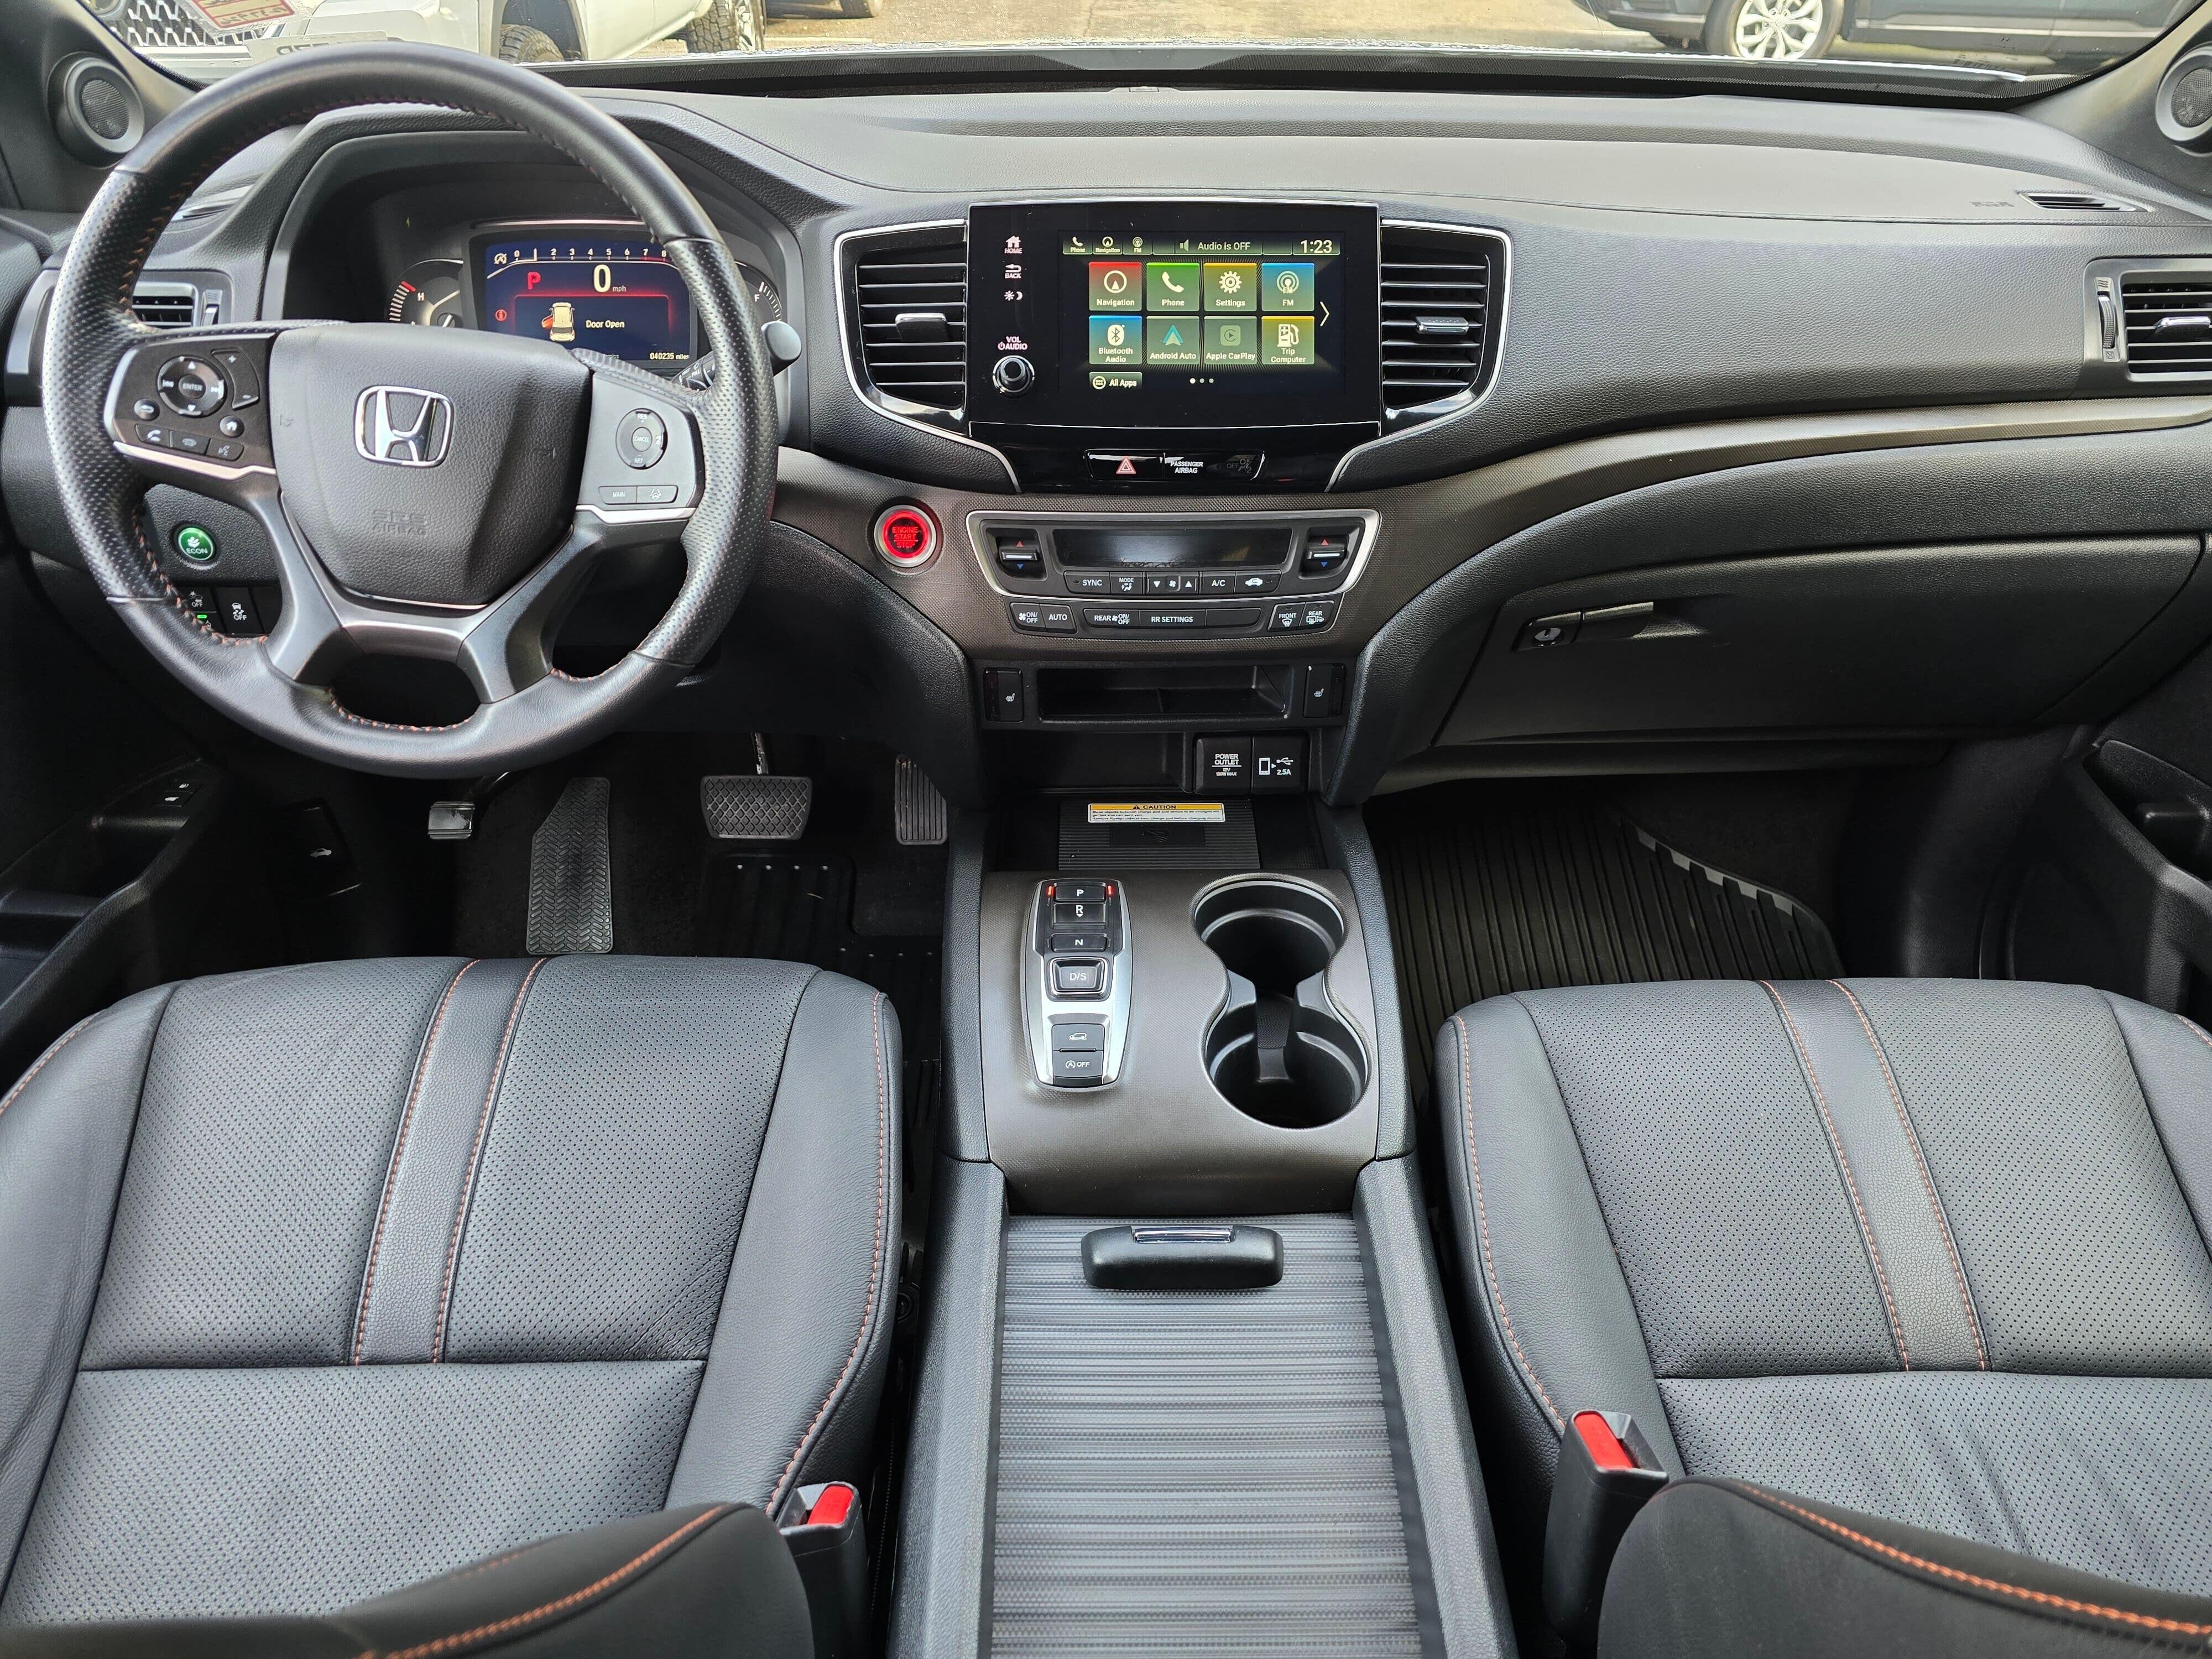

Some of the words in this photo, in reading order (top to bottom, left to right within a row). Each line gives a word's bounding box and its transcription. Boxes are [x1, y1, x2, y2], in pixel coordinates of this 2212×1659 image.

[1197, 242, 1222, 251] Audio
[1224, 242, 1232, 251] is
[1301, 239, 1332, 253] 1:23
[527, 272, 541, 290] P
[593, 264, 611, 293] 0
[418, 292, 424, 301] H
[1097, 299, 1135, 307] Navigation
[605, 320, 625, 329] Open
[182, 383, 202, 392] ENTER
[1119, 379, 1137, 388] Apps
[1076, 905, 1083, 914] R
[1070, 972, 1087, 981] D/S
